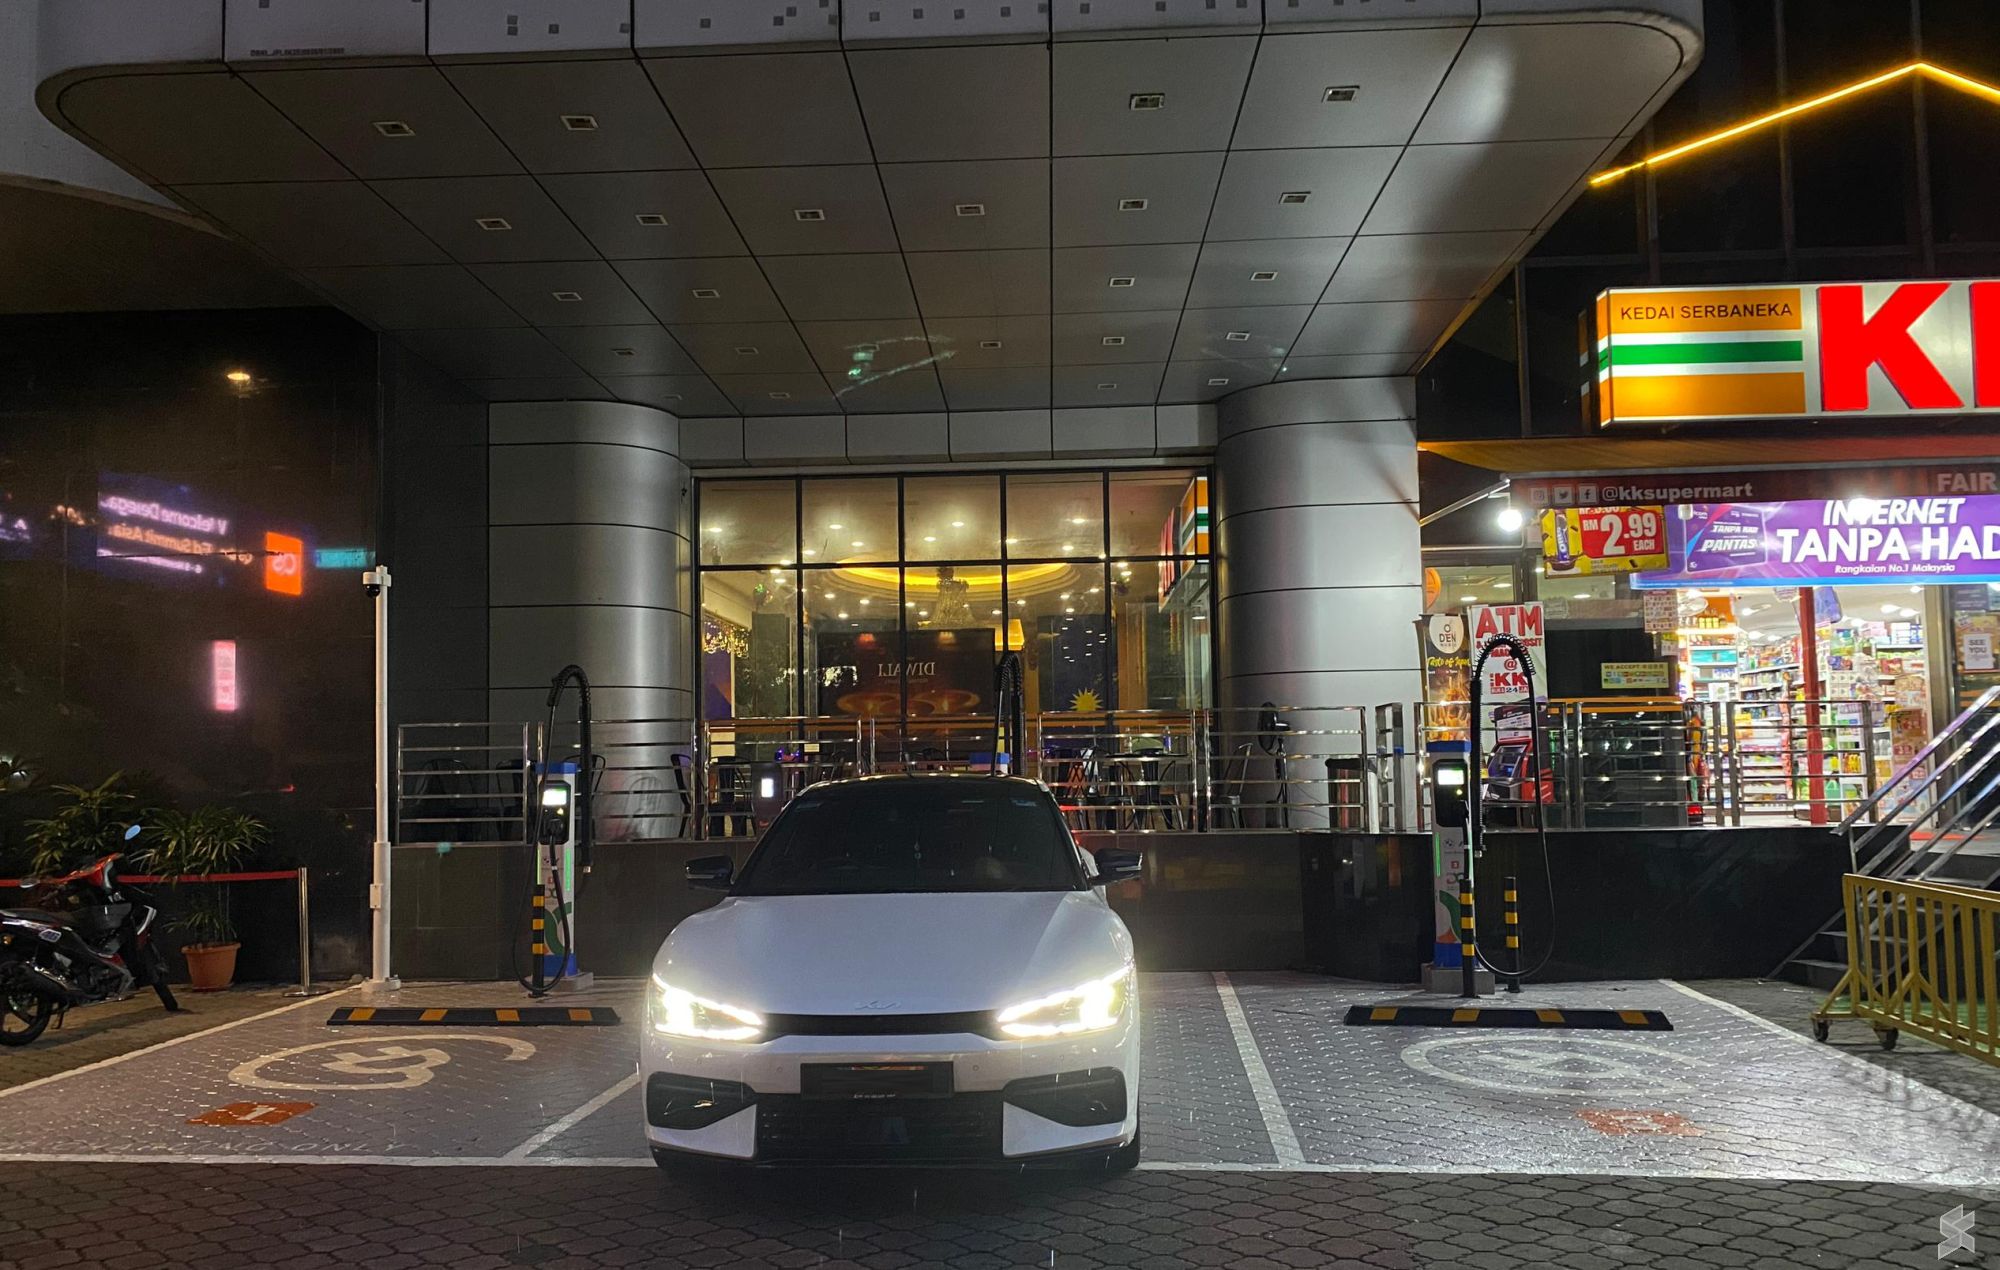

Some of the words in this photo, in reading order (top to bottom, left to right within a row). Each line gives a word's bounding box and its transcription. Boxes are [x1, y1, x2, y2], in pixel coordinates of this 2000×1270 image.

[1620, 306, 1675, 321] KEDAI
[1680, 303, 1793, 319] SERBANEKA
[1817, 281, 2000, 411] K
[1937, 472, 1998, 492] FAIR
[1602, 484, 1753, 502] @kksupermart
[1583, 518, 1598, 532] RM
[1600, 512, 1657, 556] 2.99
[1633, 539, 1655, 551] EACH
[1701, 538, 1758, 552] PANTAS
[1776, 528, 1910, 563] TANPA
[1835, 564, 1886, 576] Rangkaian
[1889, 563, 1909, 573] No.1
[1912, 563, 1956, 574] Malaysia
[1475, 606, 1543, 638] ATM
[1503, 659, 1518, 671] @
[1494, 672, 1529, 686] KK
